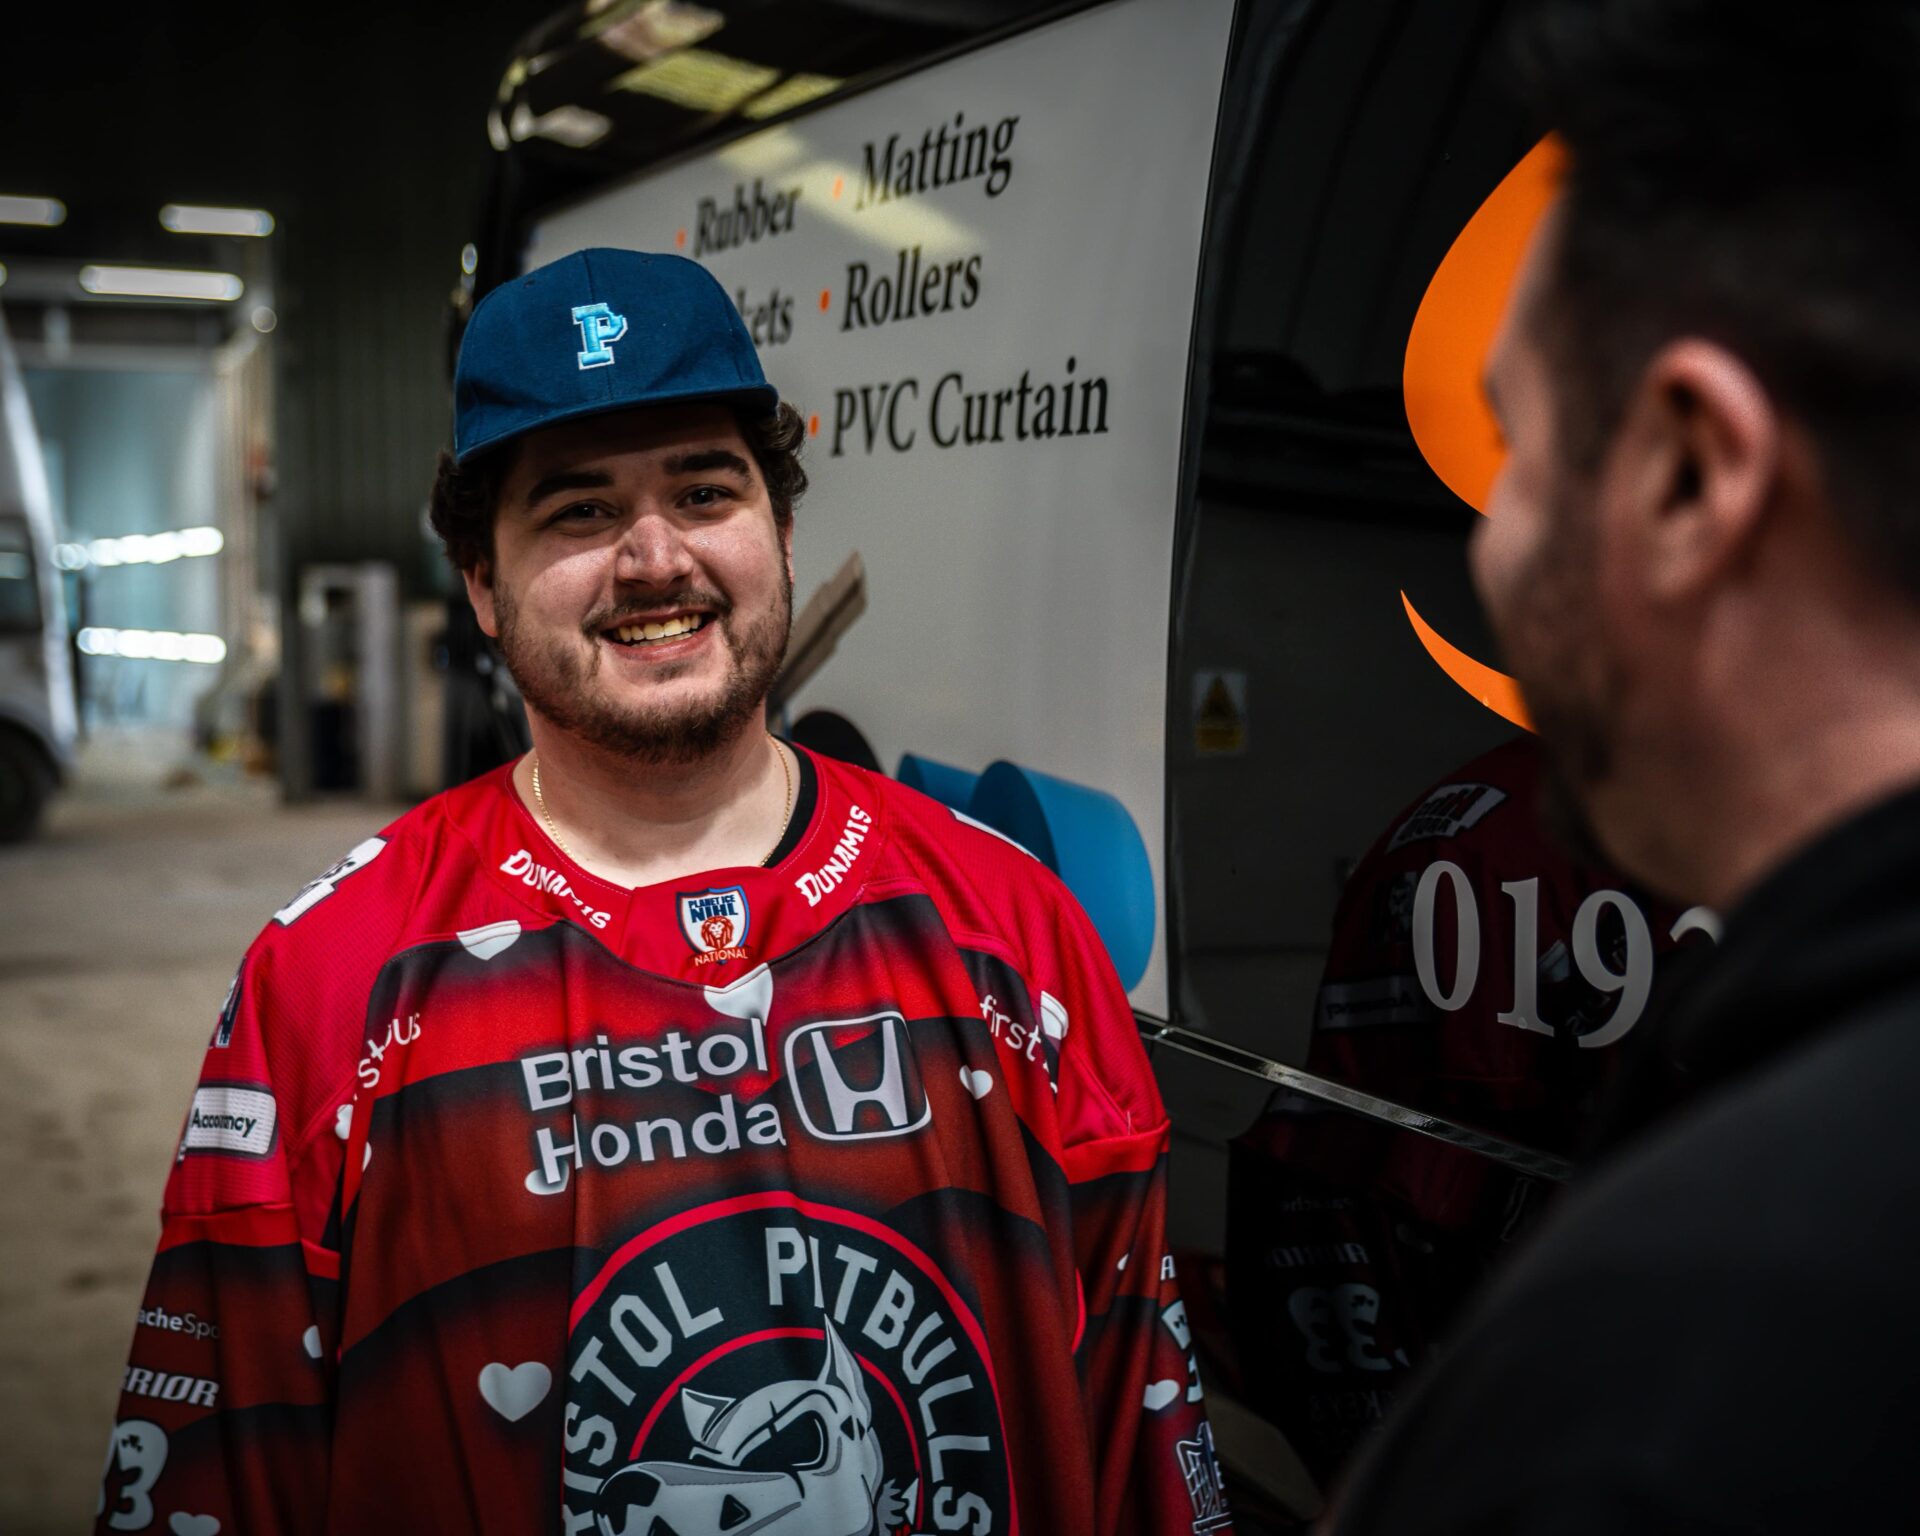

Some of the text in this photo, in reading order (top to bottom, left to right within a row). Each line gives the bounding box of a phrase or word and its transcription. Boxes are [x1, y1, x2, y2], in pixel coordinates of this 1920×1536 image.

[856, 112, 1019, 211] Matting
[694, 178, 802, 259] Rubber
[840, 245, 982, 332] Rollers
[571, 302, 628, 371] P
[830, 356, 1109, 458] PVC Curtain
[688, 894, 736, 909] PLANET ICE
[795, 805, 873, 907] DUNAMIS
[690, 903, 739, 923] NIHL
[694, 948, 749, 966] NATIONAL
[1412, 860, 1727, 1048] 019
[521, 1018, 768, 1111] Bristol
[979, 994, 1042, 1062] first
[537, 1094, 787, 1185] Honda
[562, 1261, 725, 1536] ISTOL
[765, 1227, 992, 1536] PITBULLS
